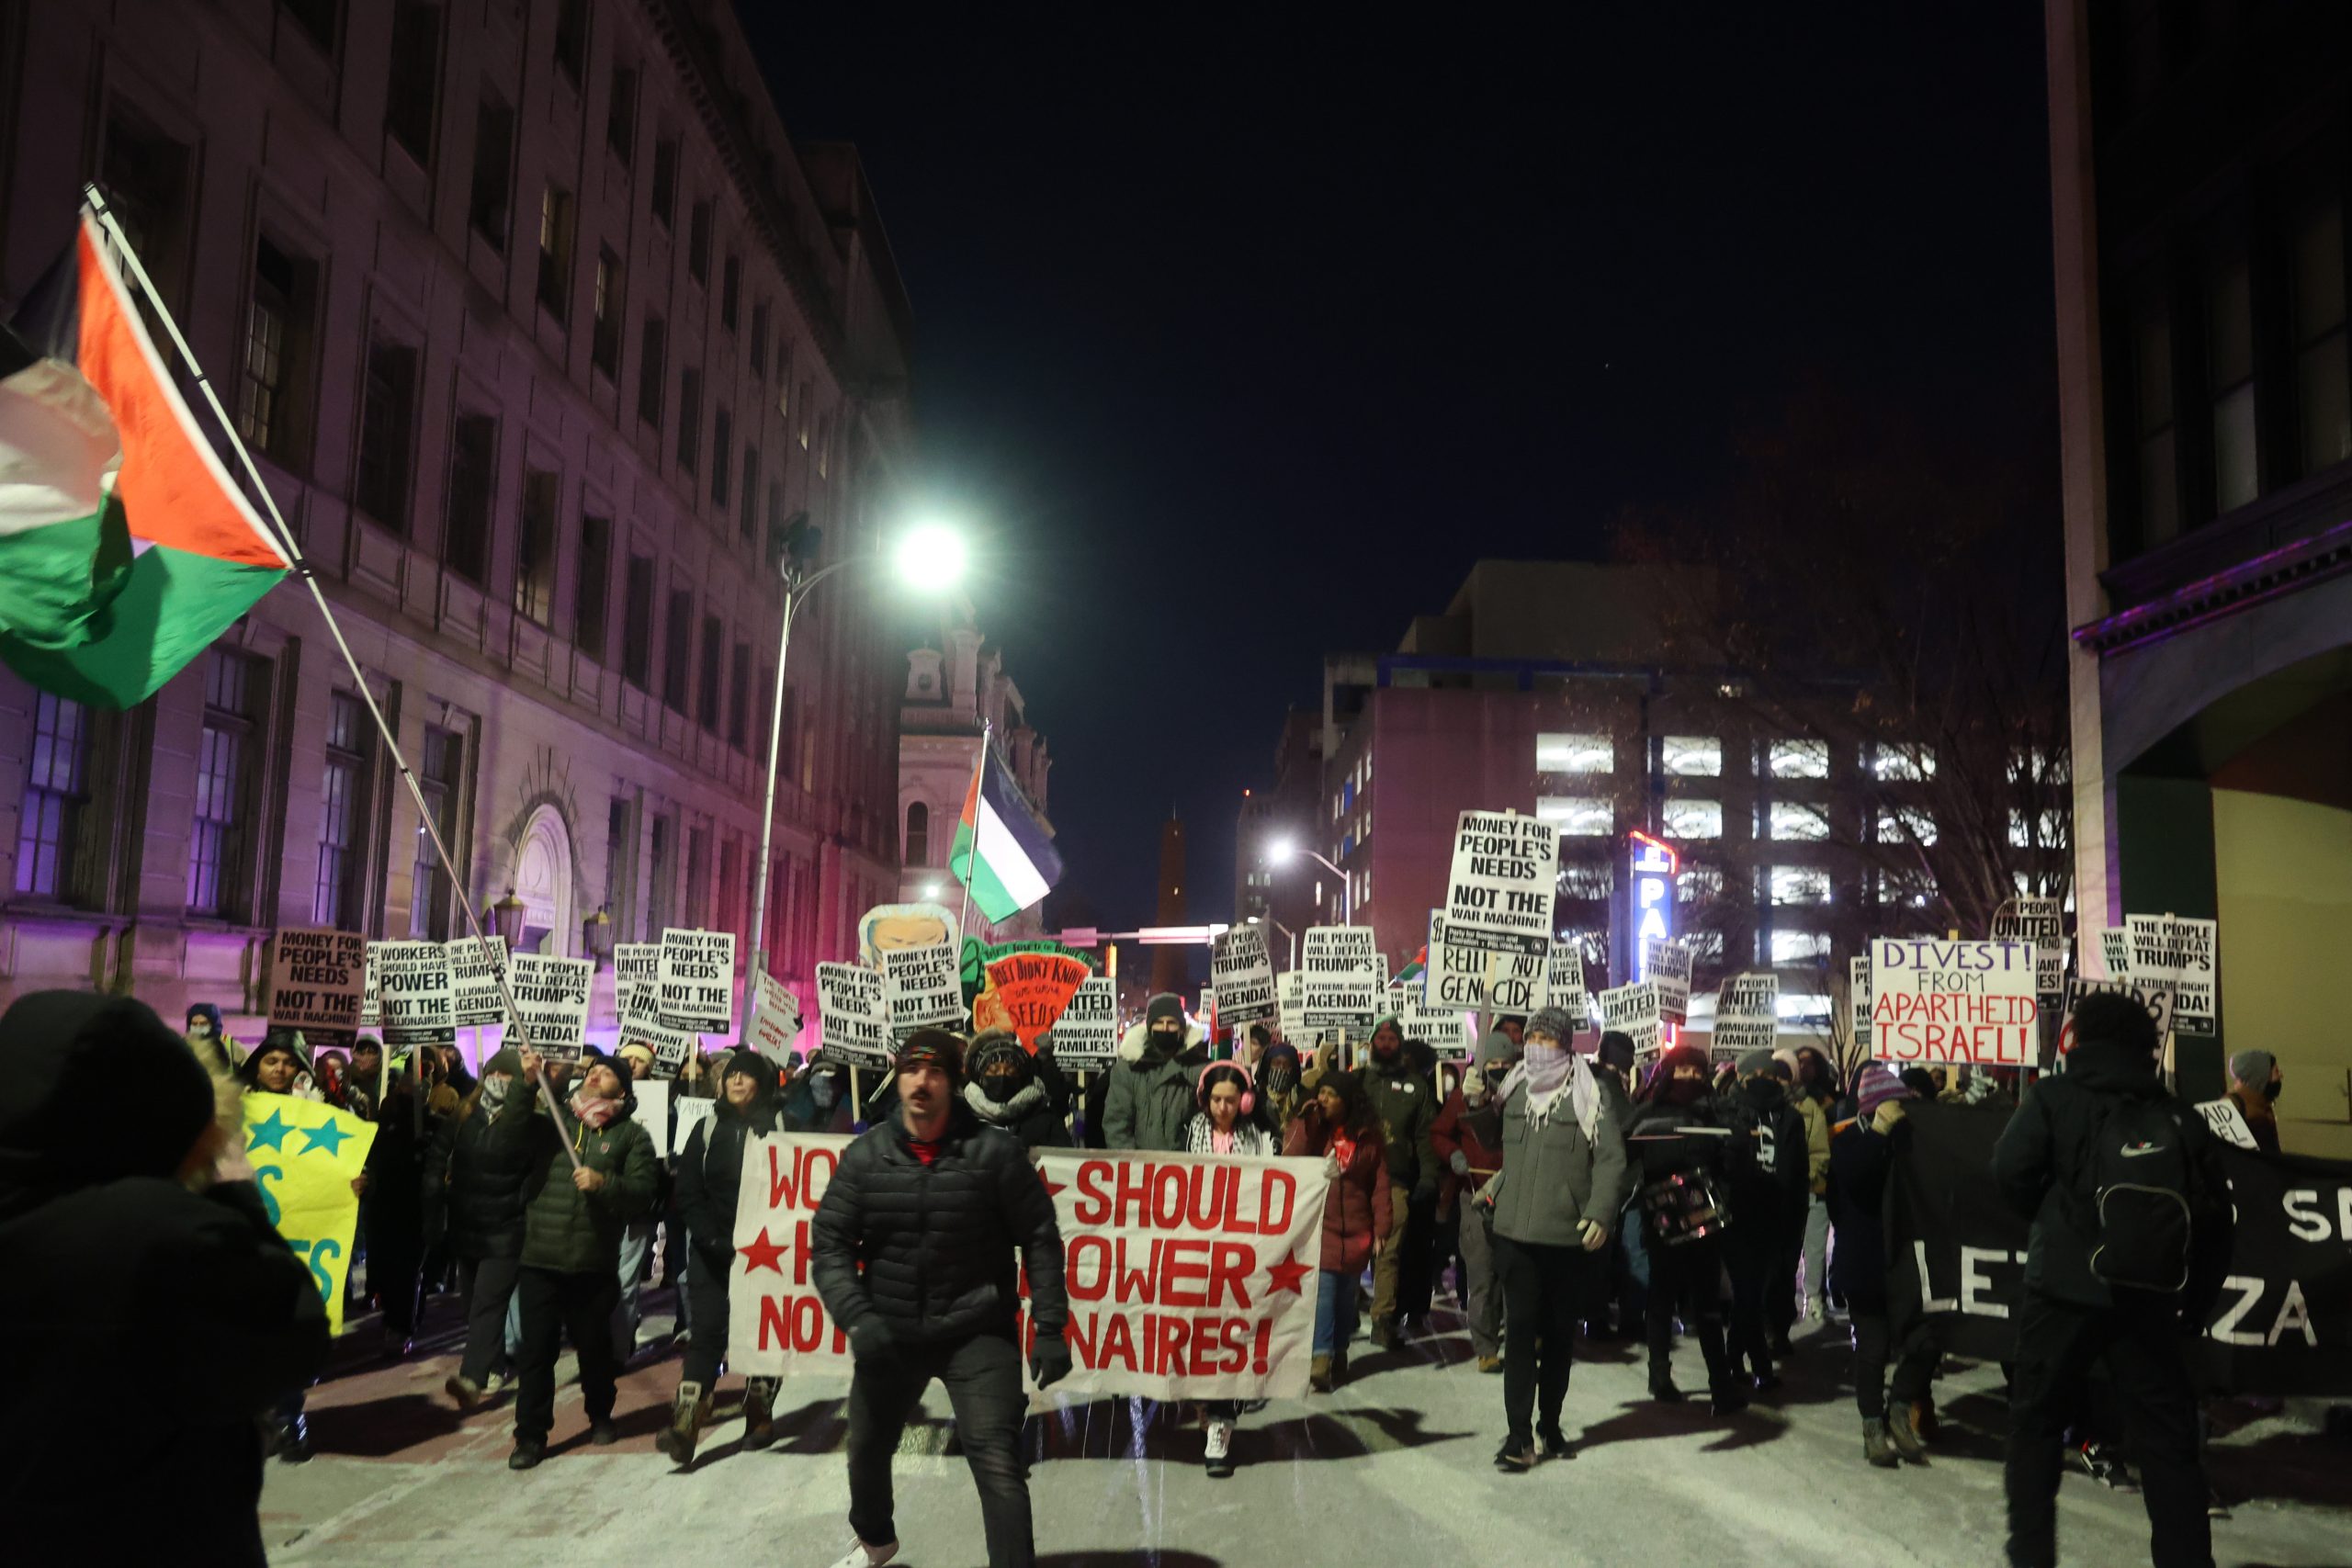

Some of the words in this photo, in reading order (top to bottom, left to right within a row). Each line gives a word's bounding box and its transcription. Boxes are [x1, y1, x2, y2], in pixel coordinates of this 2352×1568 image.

[1463, 816, 1519, 837] MONEY
[1522, 821, 1552, 841] FOR
[1460, 833, 1552, 862] PEOPLE'S
[1470, 856, 1537, 881] NEEDS
[1453, 885, 1500, 909] NOT
[1506, 889, 1549, 917] THE
[2019, 902, 2059, 916] PEOPLE
[1452, 908, 1481, 924] WAR
[1484, 911, 1546, 931] MACHINE!
[1994, 917, 2060, 937] UNITED
[1307, 932, 1327, 944] THE
[1331, 931, 1371, 943] PEOPLE
[2132, 920, 2159, 934] THE
[2163, 922, 2211, 939] PEOPLE
[282, 931, 333, 948] MONEY
[337, 934, 362, 951] FOR
[666, 932, 704, 948] MONEY
[707, 934, 730, 950] FOR
[1307, 946, 1329, 956] WILL
[1334, 945, 1373, 956] DEFEAT
[2133, 935, 2165, 948] WILL
[2166, 937, 2211, 953] DEFEAT
[278, 947, 362, 969] PEOPLE'S
[380, 946, 447, 962] WORKERS
[617, 947, 630, 957] THE
[663, 946, 730, 965] PEOPLE'S
[887, 950, 928, 965] MONEY
[931, 946, 954, 960] FOR
[1215, 946, 1233, 959] WILL
[1552, 946, 1578, 958] KERS
[1883, 941, 2032, 972] DIVEST!
[2132, 947, 2211, 972] TRUMP'S
[379, 962, 417, 973] SHOULD
[420, 961, 448, 972] HAVE
[515, 959, 540, 973] THE
[542, 961, 589, 976] PEOPLE
[671, 963, 719, 980] NEEDS
[888, 958, 956, 981] PEOPLE'S
[1214, 953, 1269, 976] TRUMP'S
[1306, 957, 1373, 973] TRUMP'S
[289, 964, 349, 986] NEEDS
[380, 973, 449, 993] POWER
[514, 972, 544, 986] WILL
[545, 975, 587, 988] DEFEAT
[820, 965, 855, 981] MONEY
[858, 971, 882, 987] FOR
[899, 973, 947, 993] NEEDS
[1739, 978, 1774, 989] PEOPLE
[1917, 971, 1984, 994] FROM
[2133, 976, 2210, 993] EXTREME-RIGHT
[513, 986, 586, 1005] TRUMP'S
[662, 983, 694, 1001] NOT
[697, 986, 728, 1004] THE
[820, 977, 883, 1003] PEOPLE'S
[1080, 981, 1111, 992] EOPLE
[1306, 983, 1372, 992] EXTREME-RIGHT
[1602, 993, 1617, 1004] THE
[1622, 983, 1653, 999] PEOPLE
[276, 989, 321, 1010] NOT
[324, 992, 359, 1013] THE
[382, 998, 413, 1016] NOT
[416, 998, 451, 1014] THE
[831, 994, 872, 1017] NEEDS
[892, 994, 925, 1015] NOT
[930, 990, 959, 1010] THE
[1217, 986, 1272, 1009] AGENDA!
[1306, 994, 1372, 1009] AGENDA!
[1560, 991, 1583, 1007] THE
[1602, 993, 1657, 1020] UNITED
[1720, 990, 1775, 1006] UNITED
[661, 1000, 681, 1012] WAR
[682, 1002, 729, 1016] MACHINE!
[1059, 1011, 1072, 1021] ILL
[1075, 1011, 1114, 1022] DEFEND
[1872, 991, 2038, 1026] APARTHEID
[273, 1010, 301, 1023] WAR
[303, 1011, 356, 1026] MACHINE!
[383, 1014, 452, 1027] BILLIONAIRES!
[823, 1012, 850, 1033] NOT
[852, 1019, 883, 1041] THE
[893, 1012, 916, 1024] WAR
[1603, 1016, 1623, 1030] WILL
[1623, 1008, 1657, 1023] DEFEND
[1715, 1021, 1775, 1033] IMMIGRANT
[623, 1024, 683, 1046] IMMIGRANT
[824, 1030, 844, 1043] WAR
[1408, 1022, 1434, 1036] NOT
[1437, 1021, 1463, 1035] THE
[1714, 1033, 1773, 1046] FAMILIES!
[1874, 1022, 2028, 1065] ISRAEL!
[1074, 1159, 1297, 1237] SHOULD
[1065, 1235, 1257, 1310] OWER
[1914, 1239, 2029, 1318] LE
